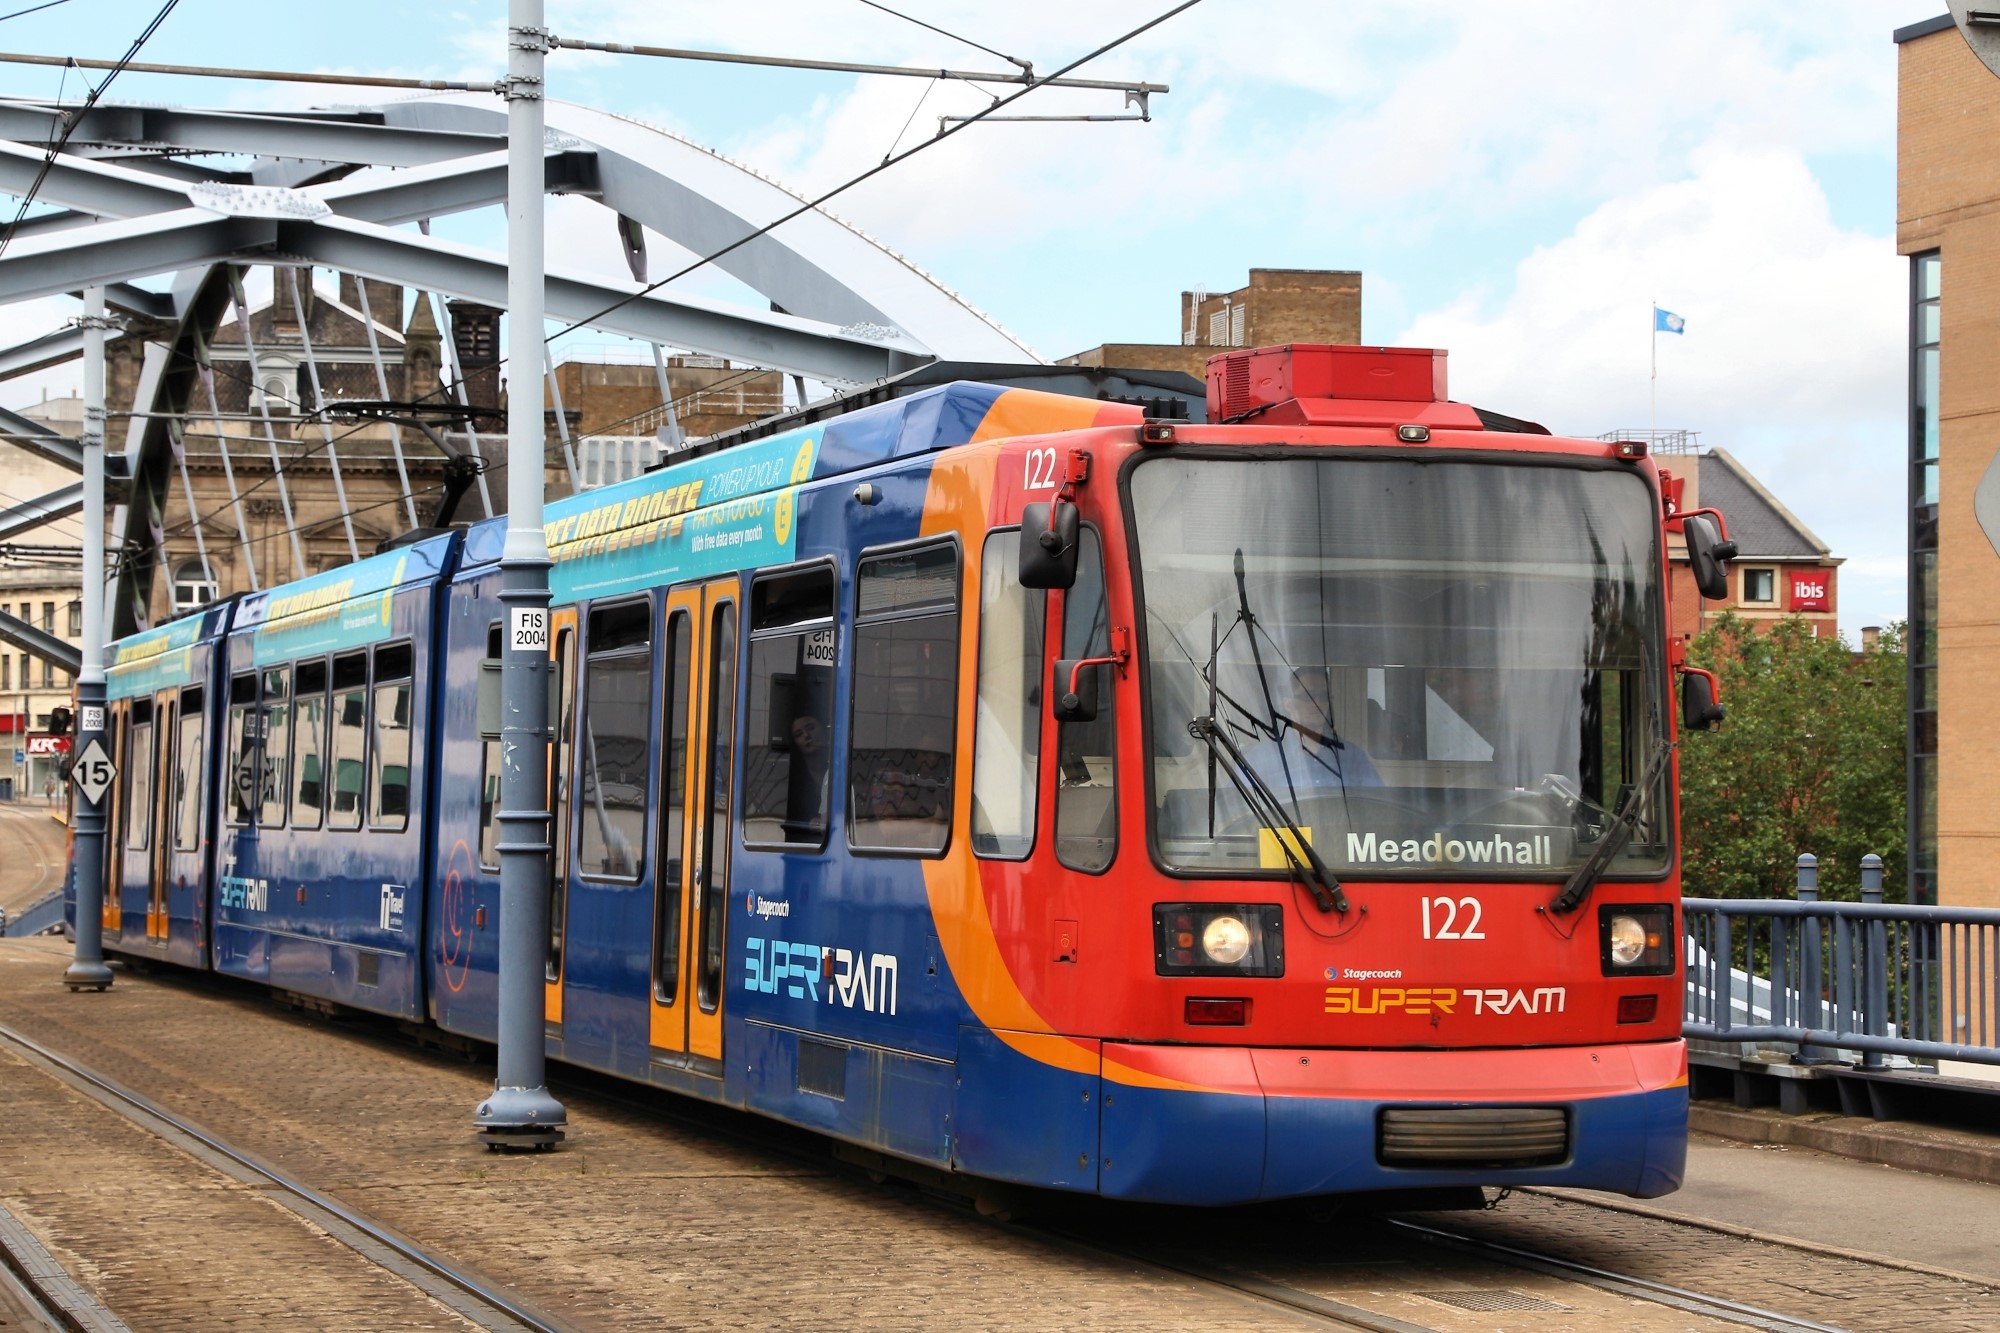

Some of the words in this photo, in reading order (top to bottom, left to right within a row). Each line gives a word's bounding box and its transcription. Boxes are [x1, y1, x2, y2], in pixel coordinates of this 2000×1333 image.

[755, 457, 784, 488] YOUR
[1023, 447, 1056, 490] 122
[691, 534, 704, 553] With
[704, 532, 715, 550] free
[716, 530, 728, 548] data
[728, 529, 744, 548] every
[744, 523, 763, 542] month
[1795, 581, 1824, 599] ibis
[521, 613, 543, 628] FIS
[516, 630, 546, 645] 2004
[88, 709, 101, 719] FIS
[28, 738, 61, 753] KFC
[78, 761, 109, 786] 15
[1346, 832, 1551, 865] Meadowhall
[756, 895, 790, 921] Stagecoach
[1421, 896, 1486, 940] 122
[1342, 967, 1402, 981] Stagecoach
[1324, 987, 1457, 1014] SUPER
[1463, 986, 1566, 1015] TRAM
